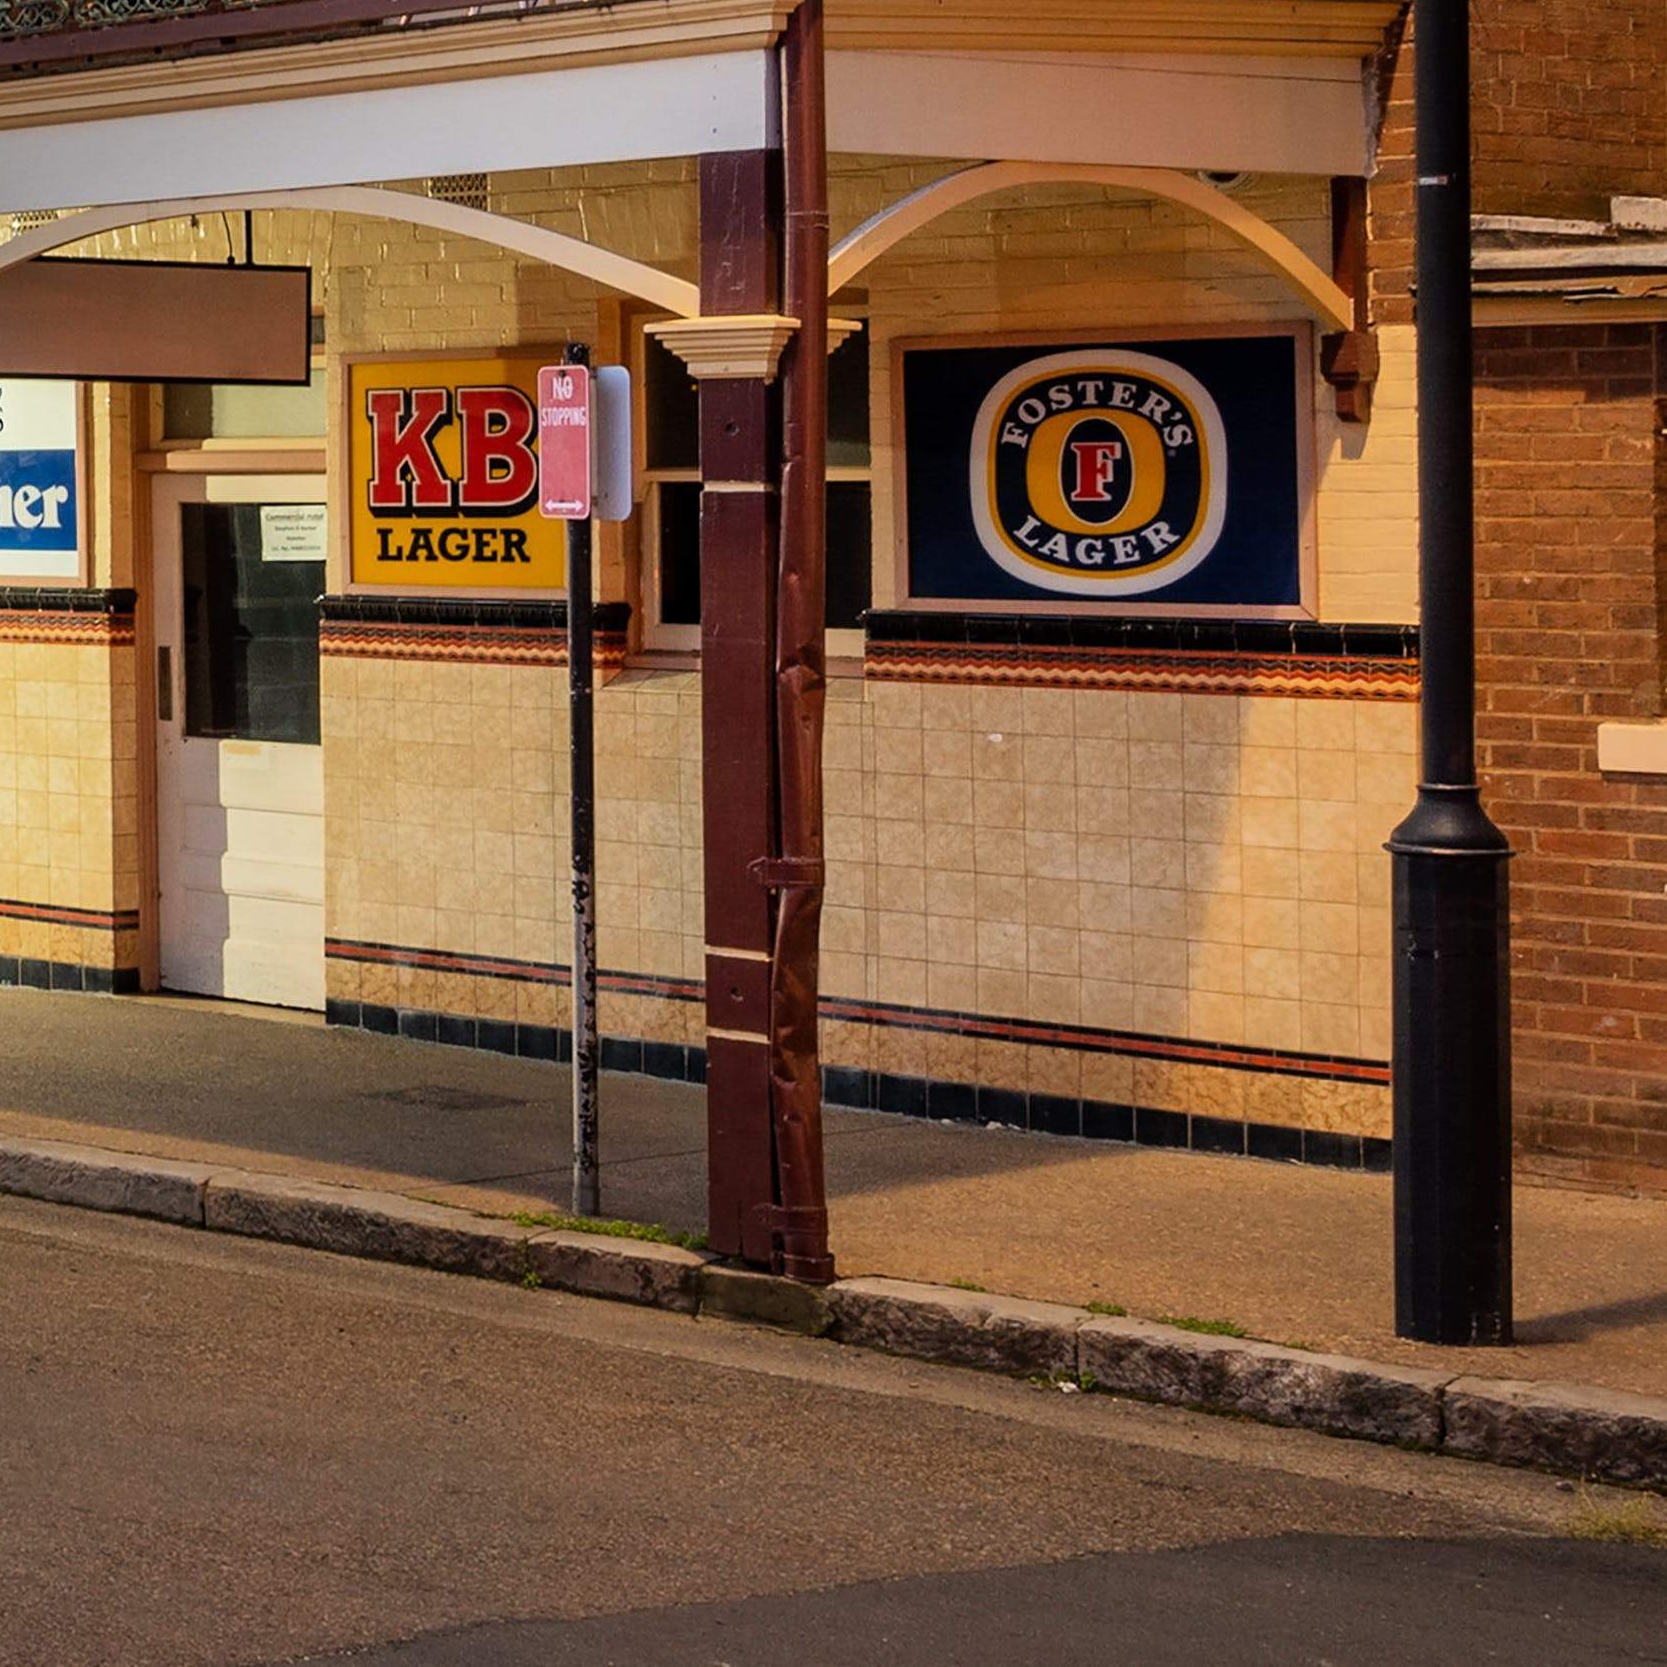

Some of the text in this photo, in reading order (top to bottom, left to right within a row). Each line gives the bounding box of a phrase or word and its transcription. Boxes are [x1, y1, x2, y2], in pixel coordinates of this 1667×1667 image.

[552, 376, 573, 401] NO
[541, 406, 586, 427] STOPPING
[1001, 380, 1194, 449] FOSTER'S
[367, 387, 539, 514] KB
[1070, 441, 1121, 502] F
[376, 528, 530, 562] LAGER
[1013, 515, 1181, 565] LAGER
